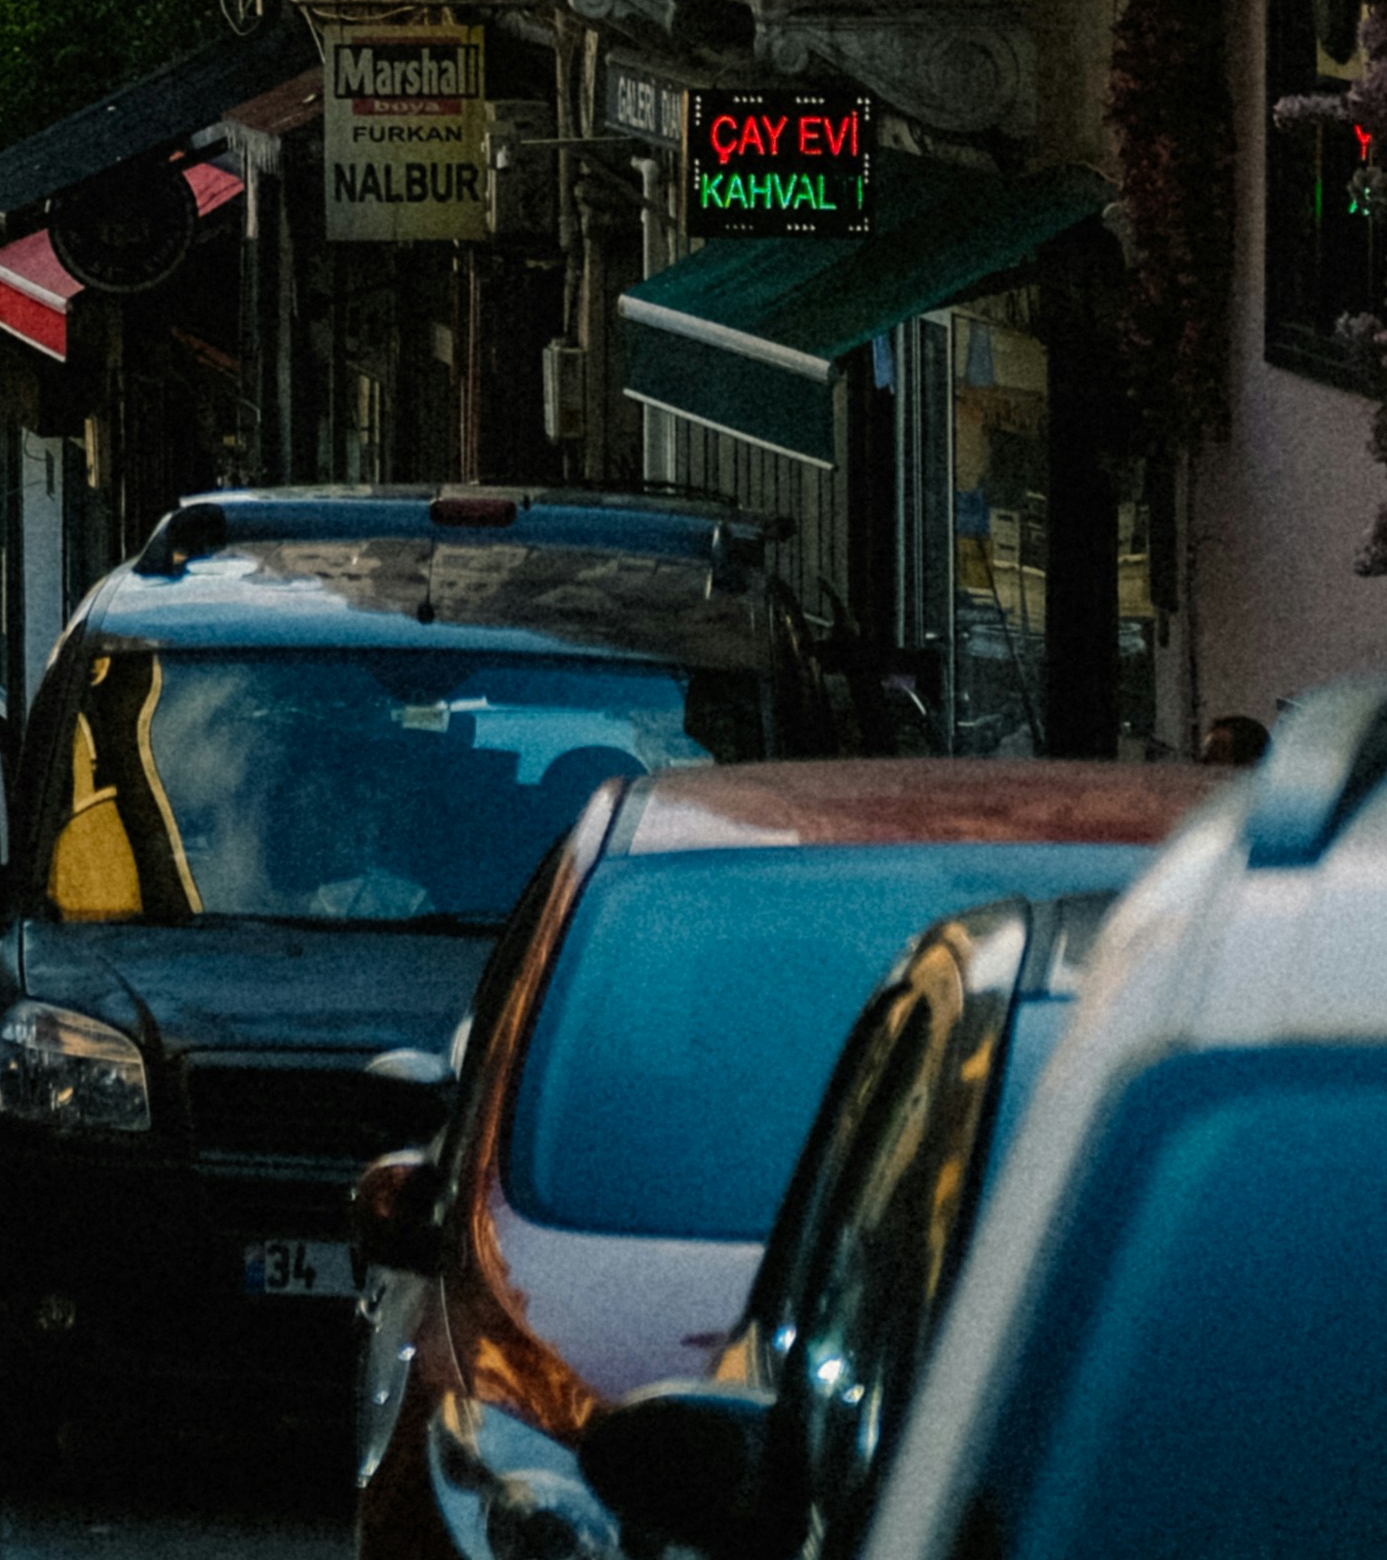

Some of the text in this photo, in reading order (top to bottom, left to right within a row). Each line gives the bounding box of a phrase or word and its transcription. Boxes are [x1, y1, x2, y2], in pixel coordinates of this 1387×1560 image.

[337, 47, 477, 96] Marshall
[352, 126, 463, 143] FURKAN
[710, 109, 859, 165] ÇAY EVİ
[334, 162, 481, 204] NALBUR
[700, 172, 863, 210] KAHVALI
[268, 1244, 316, 1290] 34
